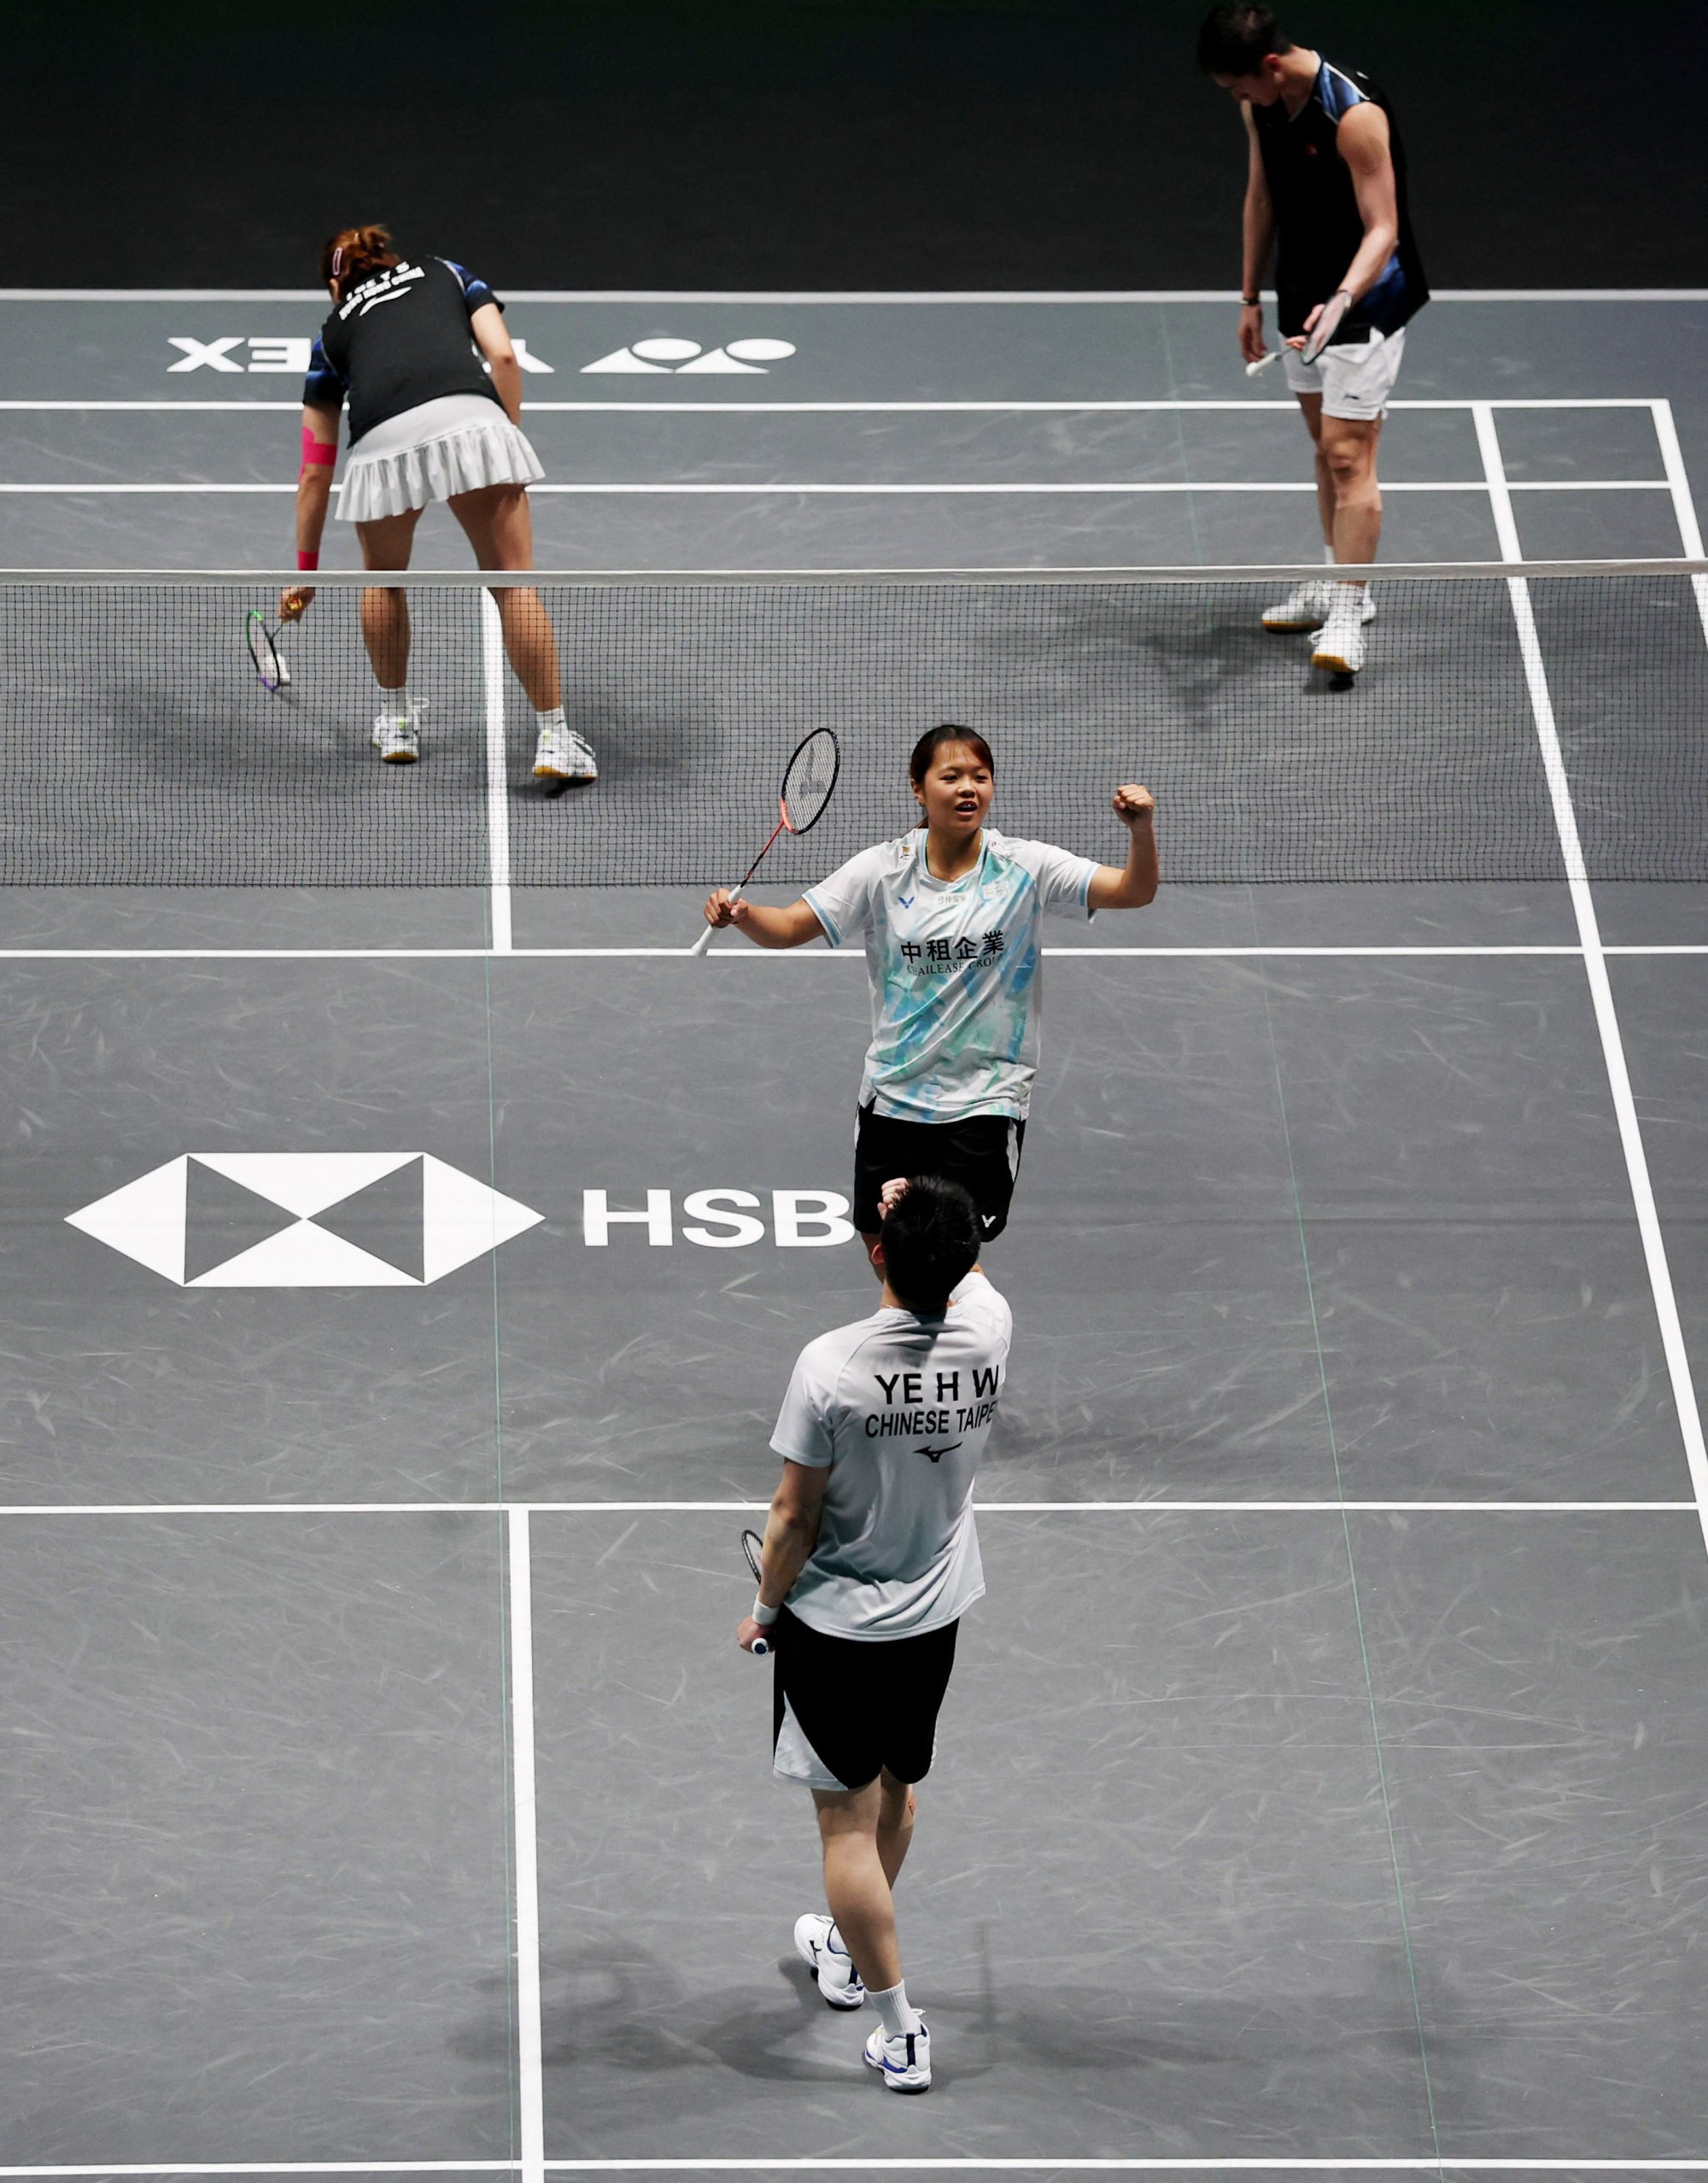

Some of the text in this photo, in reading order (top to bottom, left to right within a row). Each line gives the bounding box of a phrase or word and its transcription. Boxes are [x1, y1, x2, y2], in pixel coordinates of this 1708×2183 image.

[167, 337, 555, 373] YEX
[901, 930, 1004, 964] 中租企業
[583, 1188, 855, 1248] HSB
[874, 1365, 999, 1405] YE H W
[865, 1400, 997, 1438] CHINESE TAIPE
